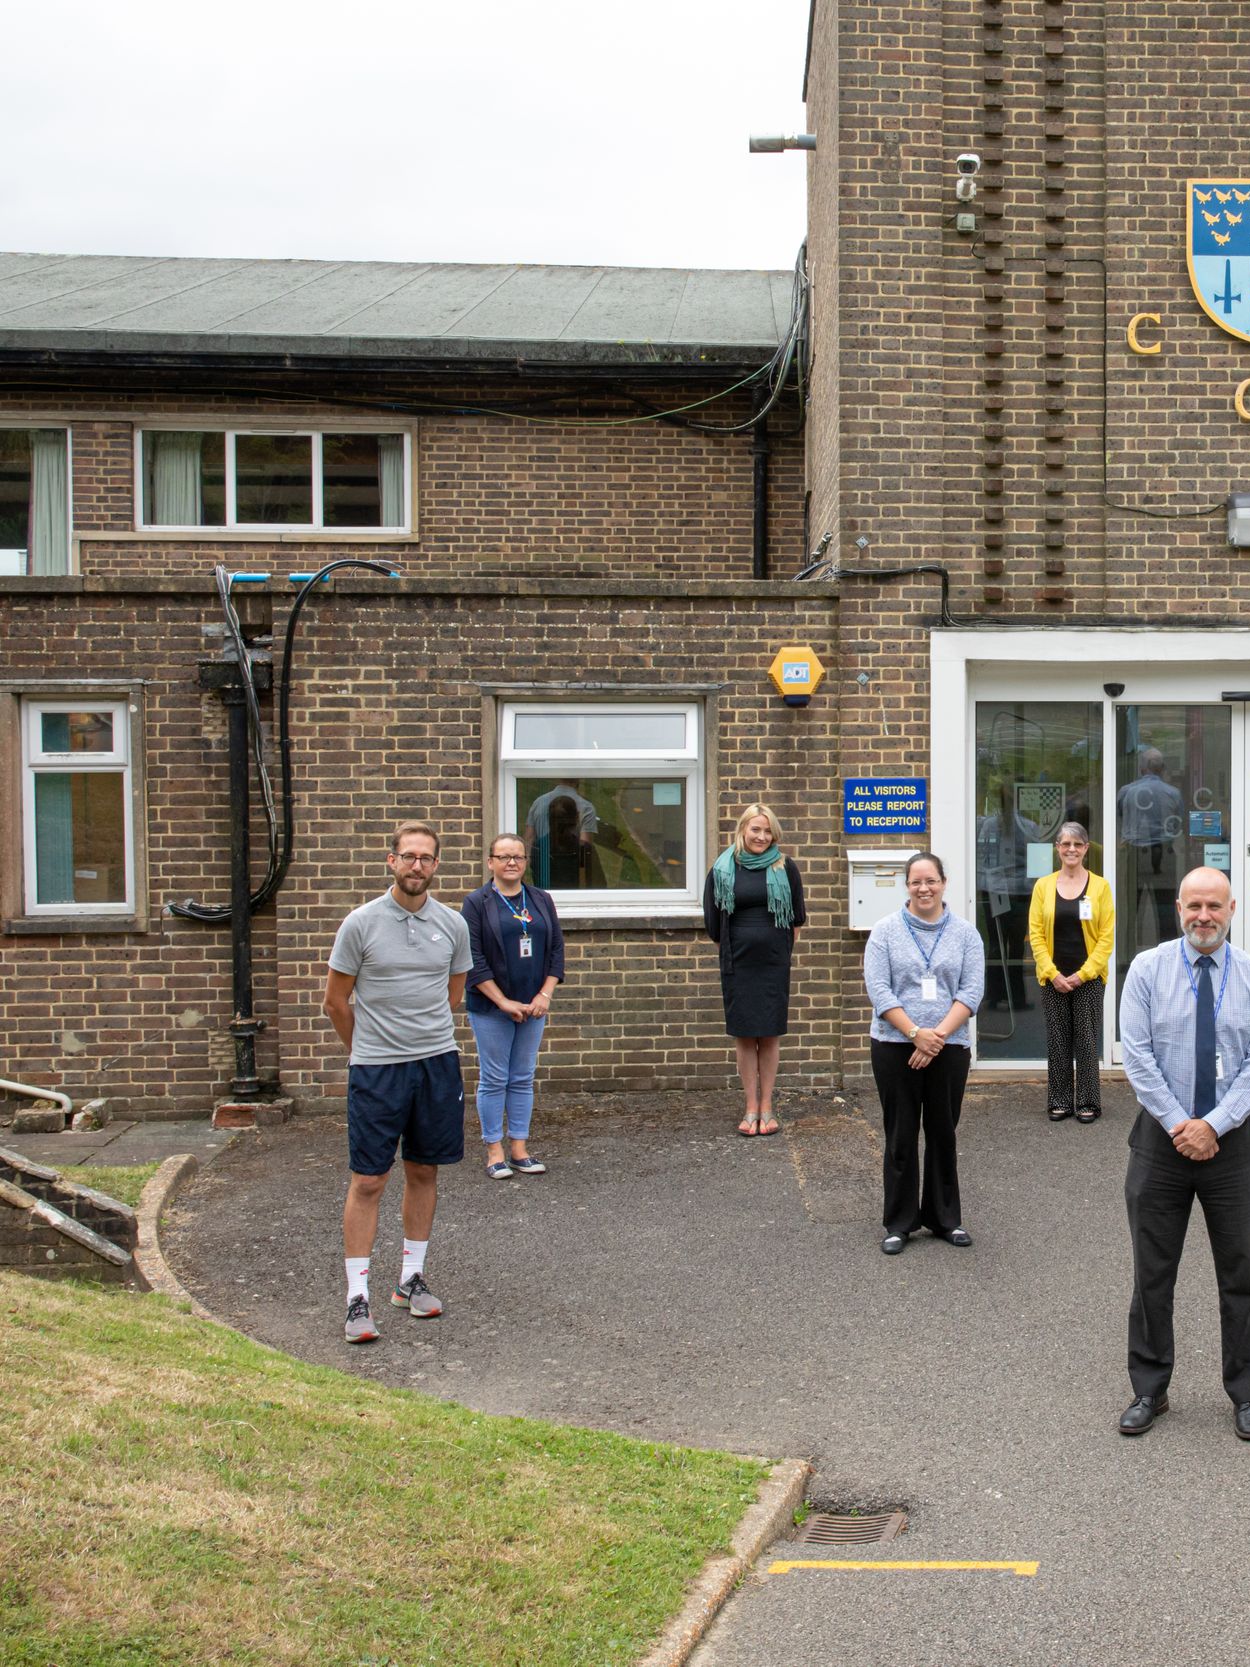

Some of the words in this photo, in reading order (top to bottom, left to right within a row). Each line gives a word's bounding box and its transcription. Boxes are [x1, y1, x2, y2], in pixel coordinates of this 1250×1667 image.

[1127, 312, 1161, 354] C
[784, 667, 809, 679] ADT
[854, 786, 871, 796] ALL
[874, 786, 916, 796] VISITORS
[1193, 787, 1213, 811] C
[847, 801, 883, 811] PLEASE
[887, 801, 925, 811] REPORT
[850, 817, 863, 827] TO
[867, 816, 920, 827] RECEPTION
[1163, 815, 1183, 838] C
